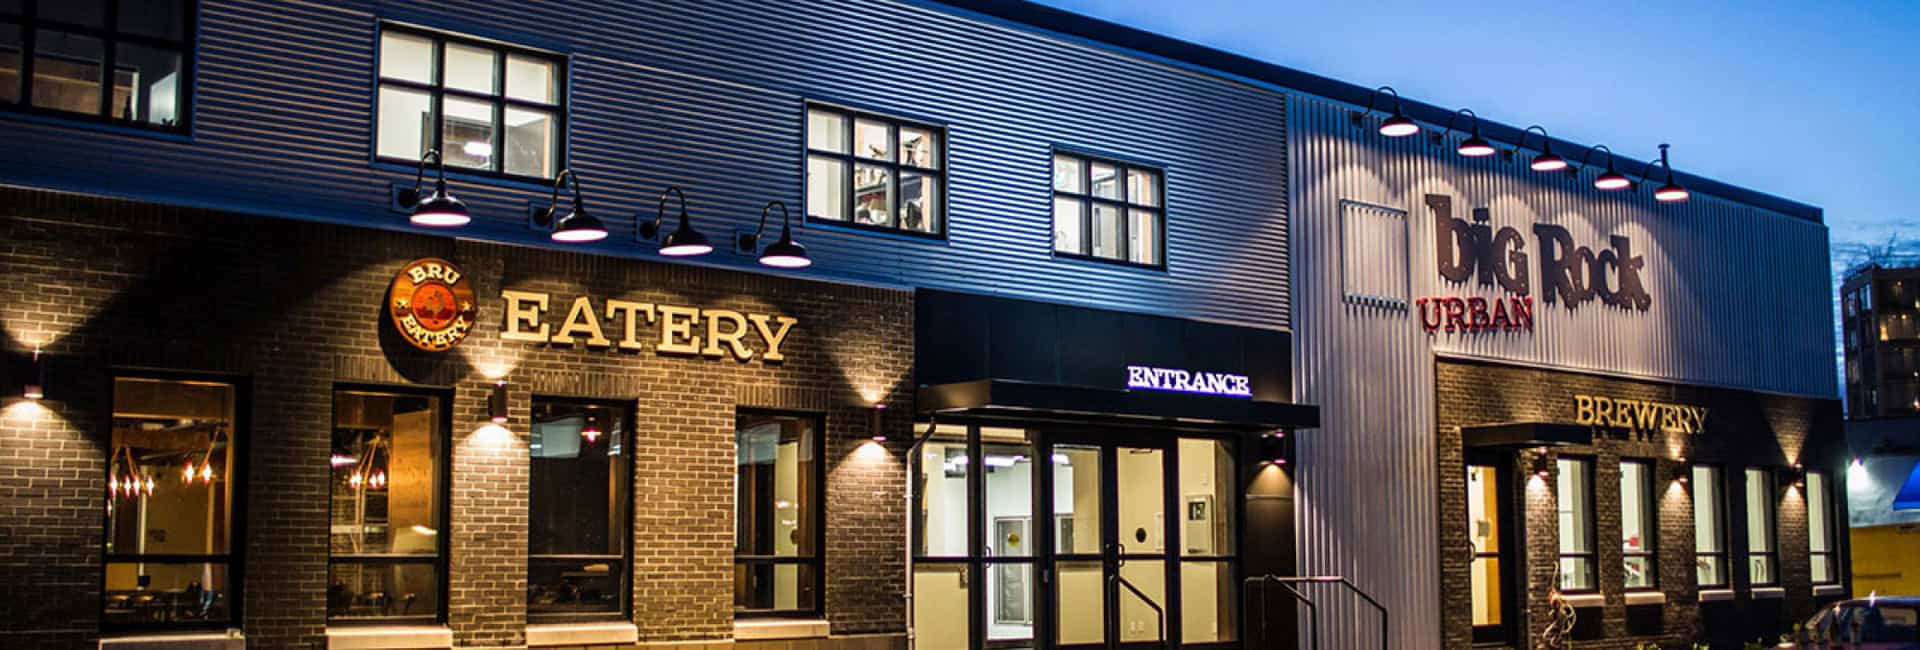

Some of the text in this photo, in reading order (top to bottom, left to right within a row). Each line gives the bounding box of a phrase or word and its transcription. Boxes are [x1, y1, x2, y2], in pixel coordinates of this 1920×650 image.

[408, 263, 461, 284] BRU
[402, 313, 468, 345] EATERY
[501, 290, 798, 361] EATERY
[1416, 297, 1534, 331] URBAN
[1127, 366, 1250, 396] ENTRANCE
[1574, 395, 1708, 433] BREWERY
